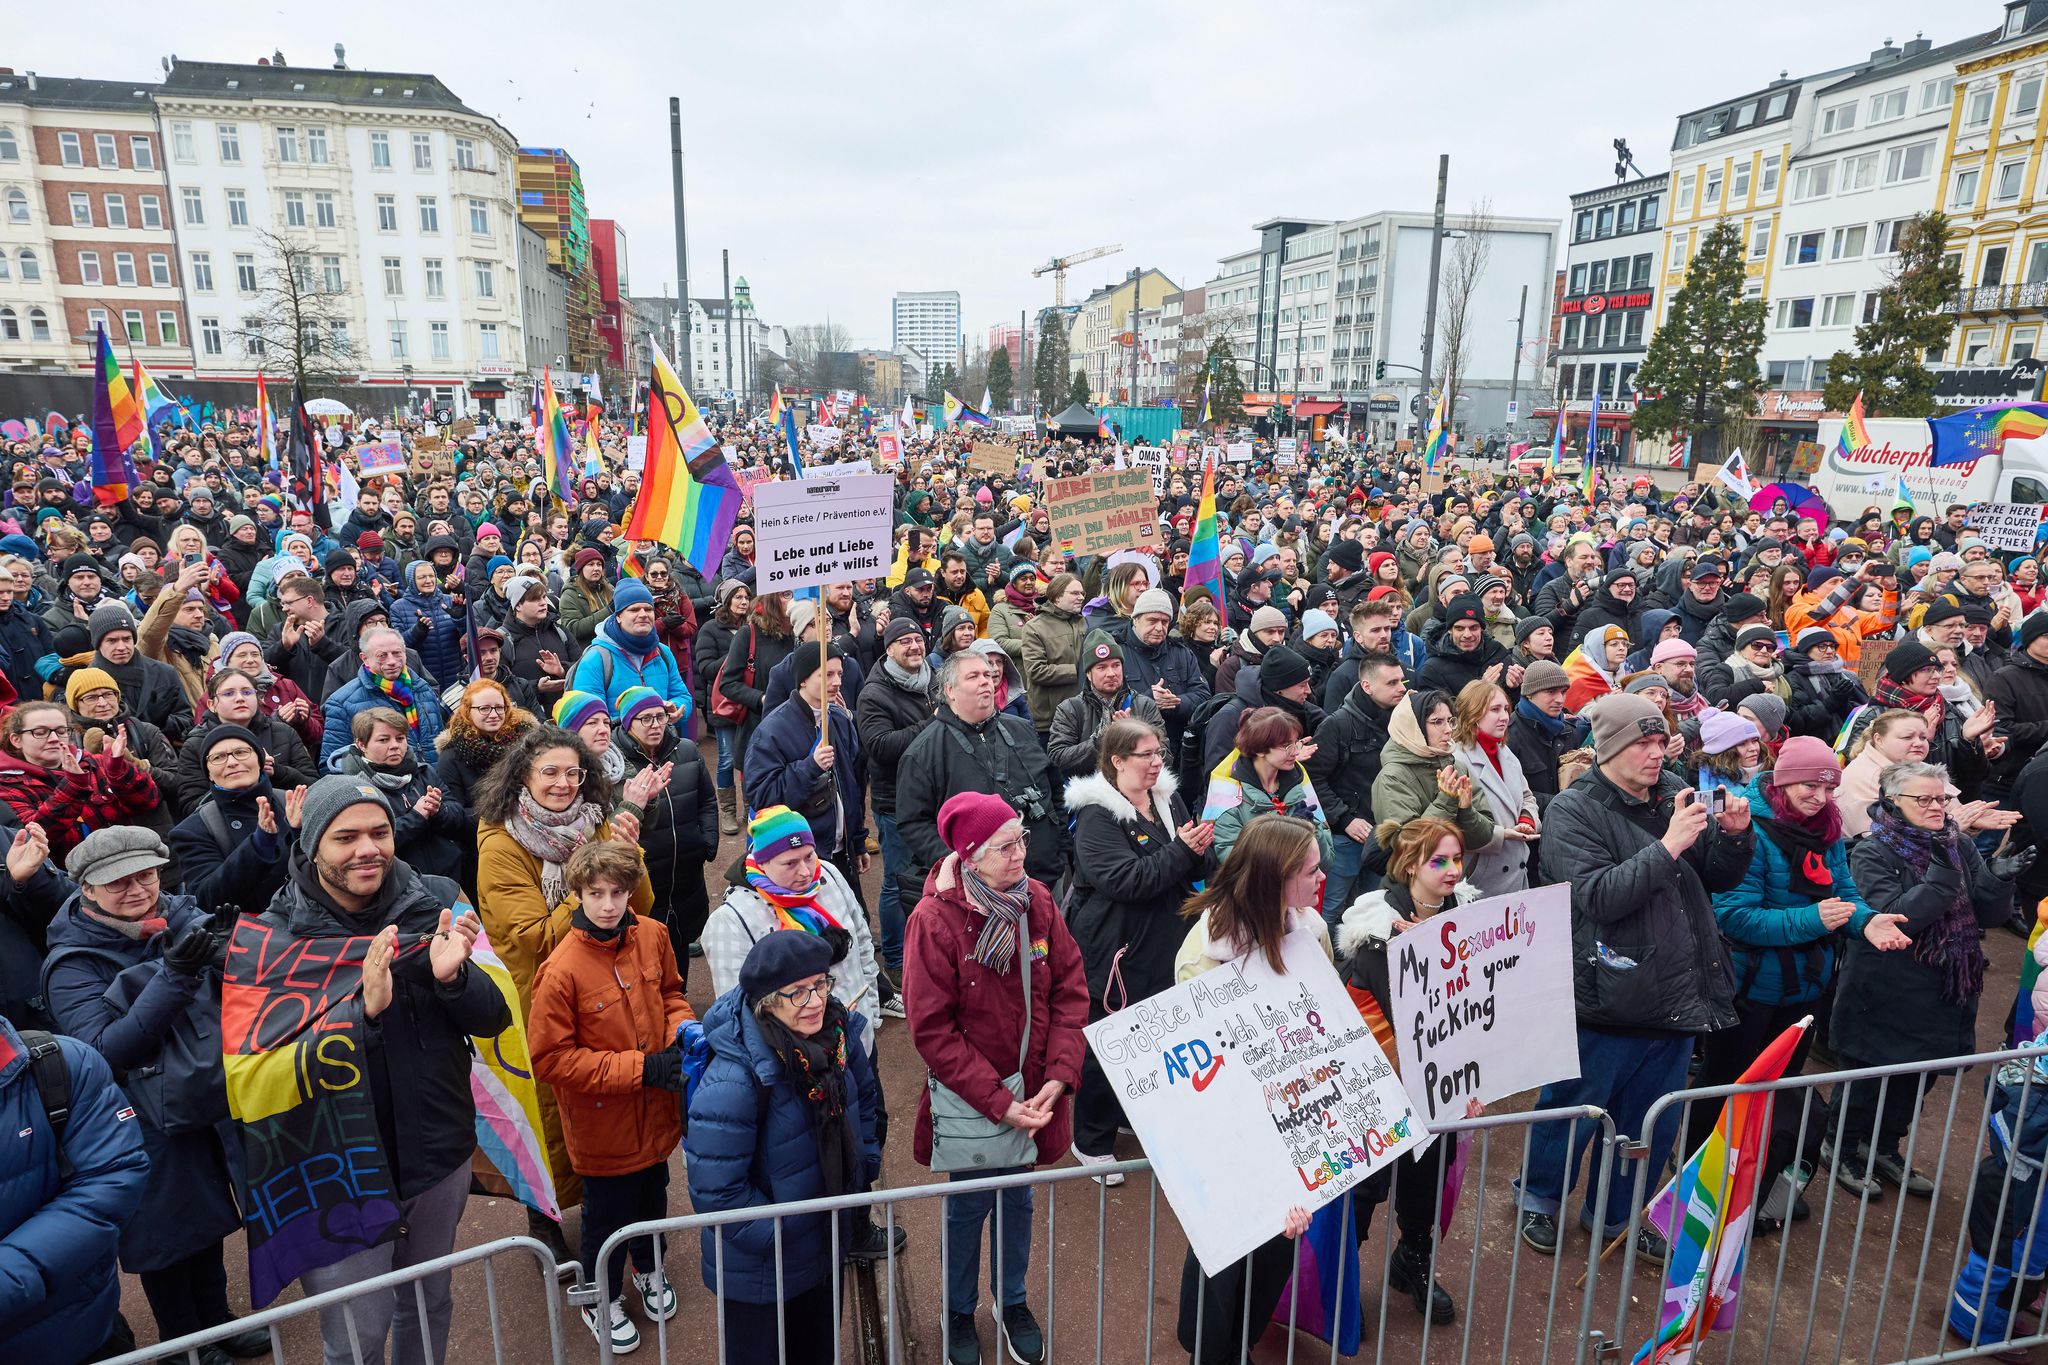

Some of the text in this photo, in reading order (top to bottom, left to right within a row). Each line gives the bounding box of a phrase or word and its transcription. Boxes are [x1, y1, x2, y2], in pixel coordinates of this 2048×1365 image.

[1627, 293, 1651, 306] HOUSE
[1138, 450, 1160, 462] OMAS
[1046, 477, 1091, 503] LIEBE
[1093, 475, 1116, 492] IST
[761, 518, 780, 528] Hein
[783, 516, 790, 524] &
[792, 514, 814, 524] Fiete
[822, 509, 870, 520] Prävention
[872, 506, 887, 516] e.V.
[1054, 507, 1156, 542] WEN DU WÄHLST
[1972, 515, 2038, 528] WE'RE QUEER
[1977, 504, 2038, 516] WE'RE HERE
[1991, 526, 2034, 537] STRONGER
[769, 570, 784, 582] so
[788, 564, 811, 578] wie
[844, 555, 878, 570] willst
[774, 539, 874, 562] Lebe und Liebe
[1399, 902, 1536, 998] My Sexuality
[1428, 954, 1520, 1014] is not your
[1094, 962, 1258, 1065] Größte Moral
[1253, 1002, 1289, 1030] bin
[1288, 982, 1320, 1018] mit
[1242, 1025, 1314, 1066] einer Frau
[1412, 994, 1496, 1062] fucking
[300, 1033, 361, 1099] IS
[1125, 1068, 1159, 1100] der
[1362, 1055, 1392, 1082] hab
[1262, 1060, 1346, 1113] Migrations-
[1424, 1060, 1480, 1120] Porn
[1283, 1126, 1306, 1149] mit
[1304, 1121, 1324, 1138] ihr
[1322, 1110, 1338, 1130] 2
[1291, 1105, 1388, 1168] aber bin nicht
[246, 1145, 389, 1237] HERE
